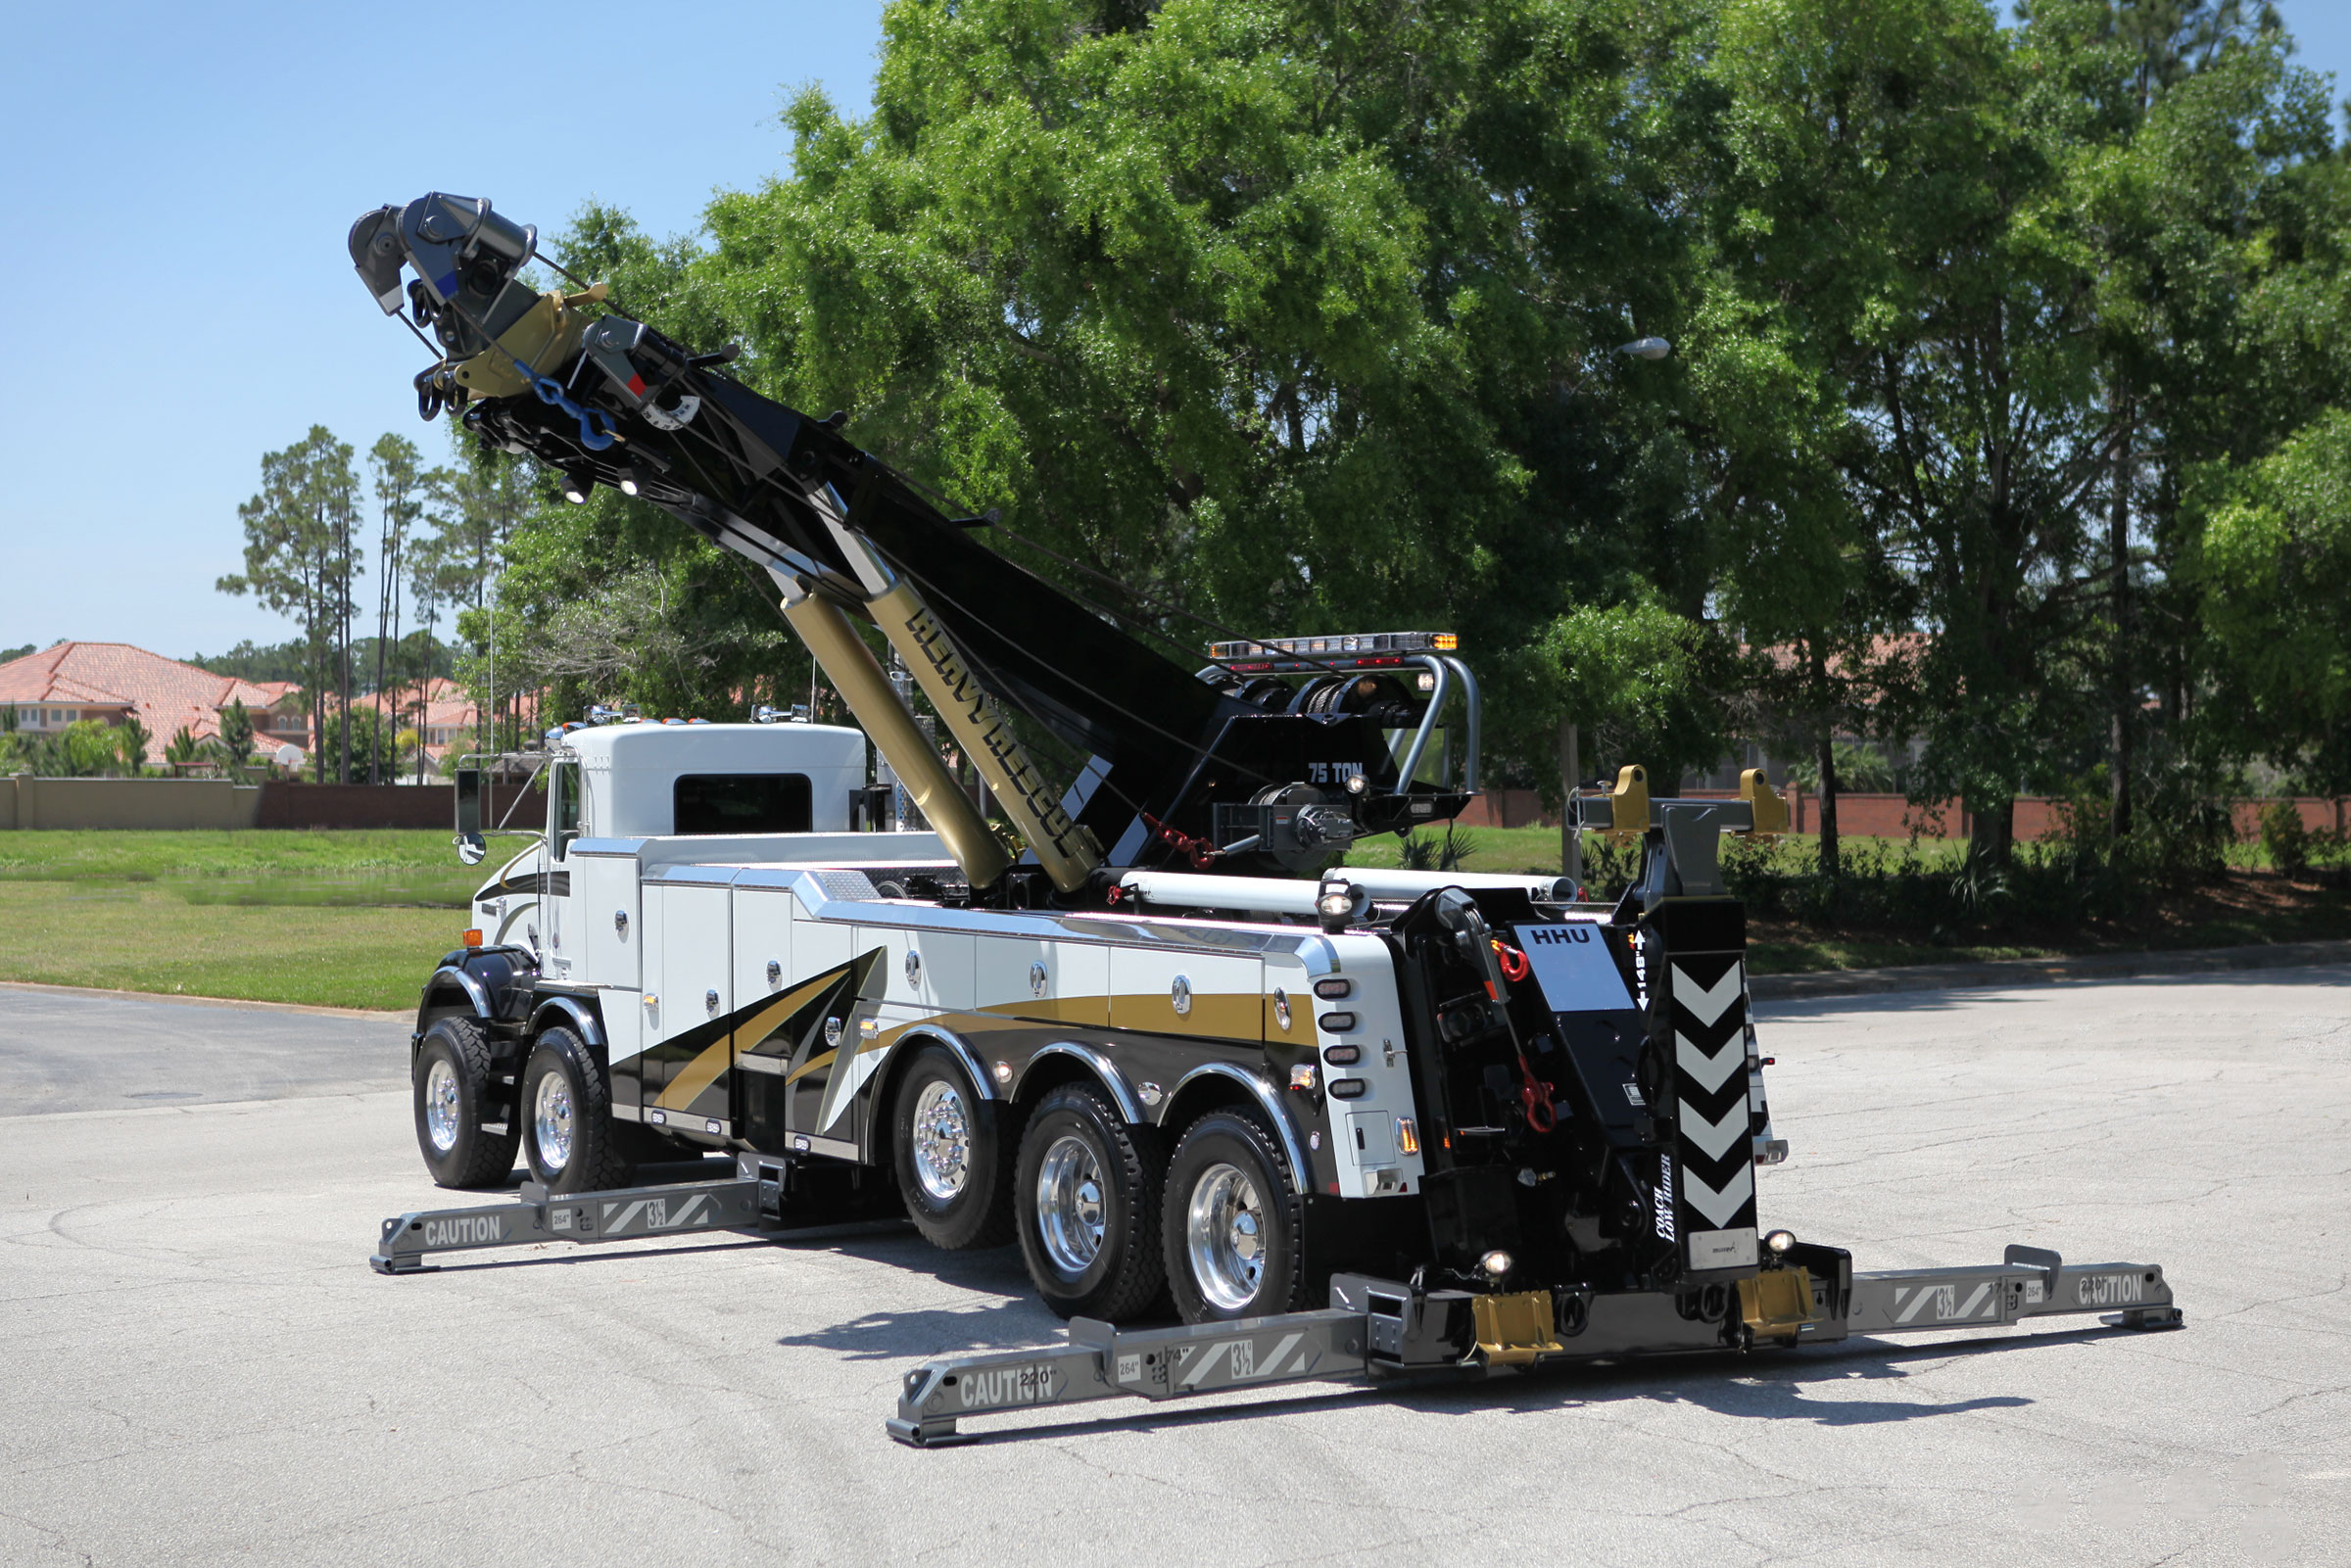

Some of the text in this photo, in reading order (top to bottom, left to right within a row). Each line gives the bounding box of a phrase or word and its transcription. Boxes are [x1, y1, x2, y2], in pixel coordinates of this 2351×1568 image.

[905, 607, 1082, 859] HEAVY RESCUE
[1308, 762, 1363, 784] 75 TON
[1530, 928, 1590, 944] HHU
[1654, 1186, 1666, 1239] COACH
[1660, 1154, 1675, 1243] LOW RIDER
[425, 1215, 501, 1246] CAUTION
[2079, 1274, 2142, 1306] CAUTION
[960, 1365, 1052, 1407] CAUTION
